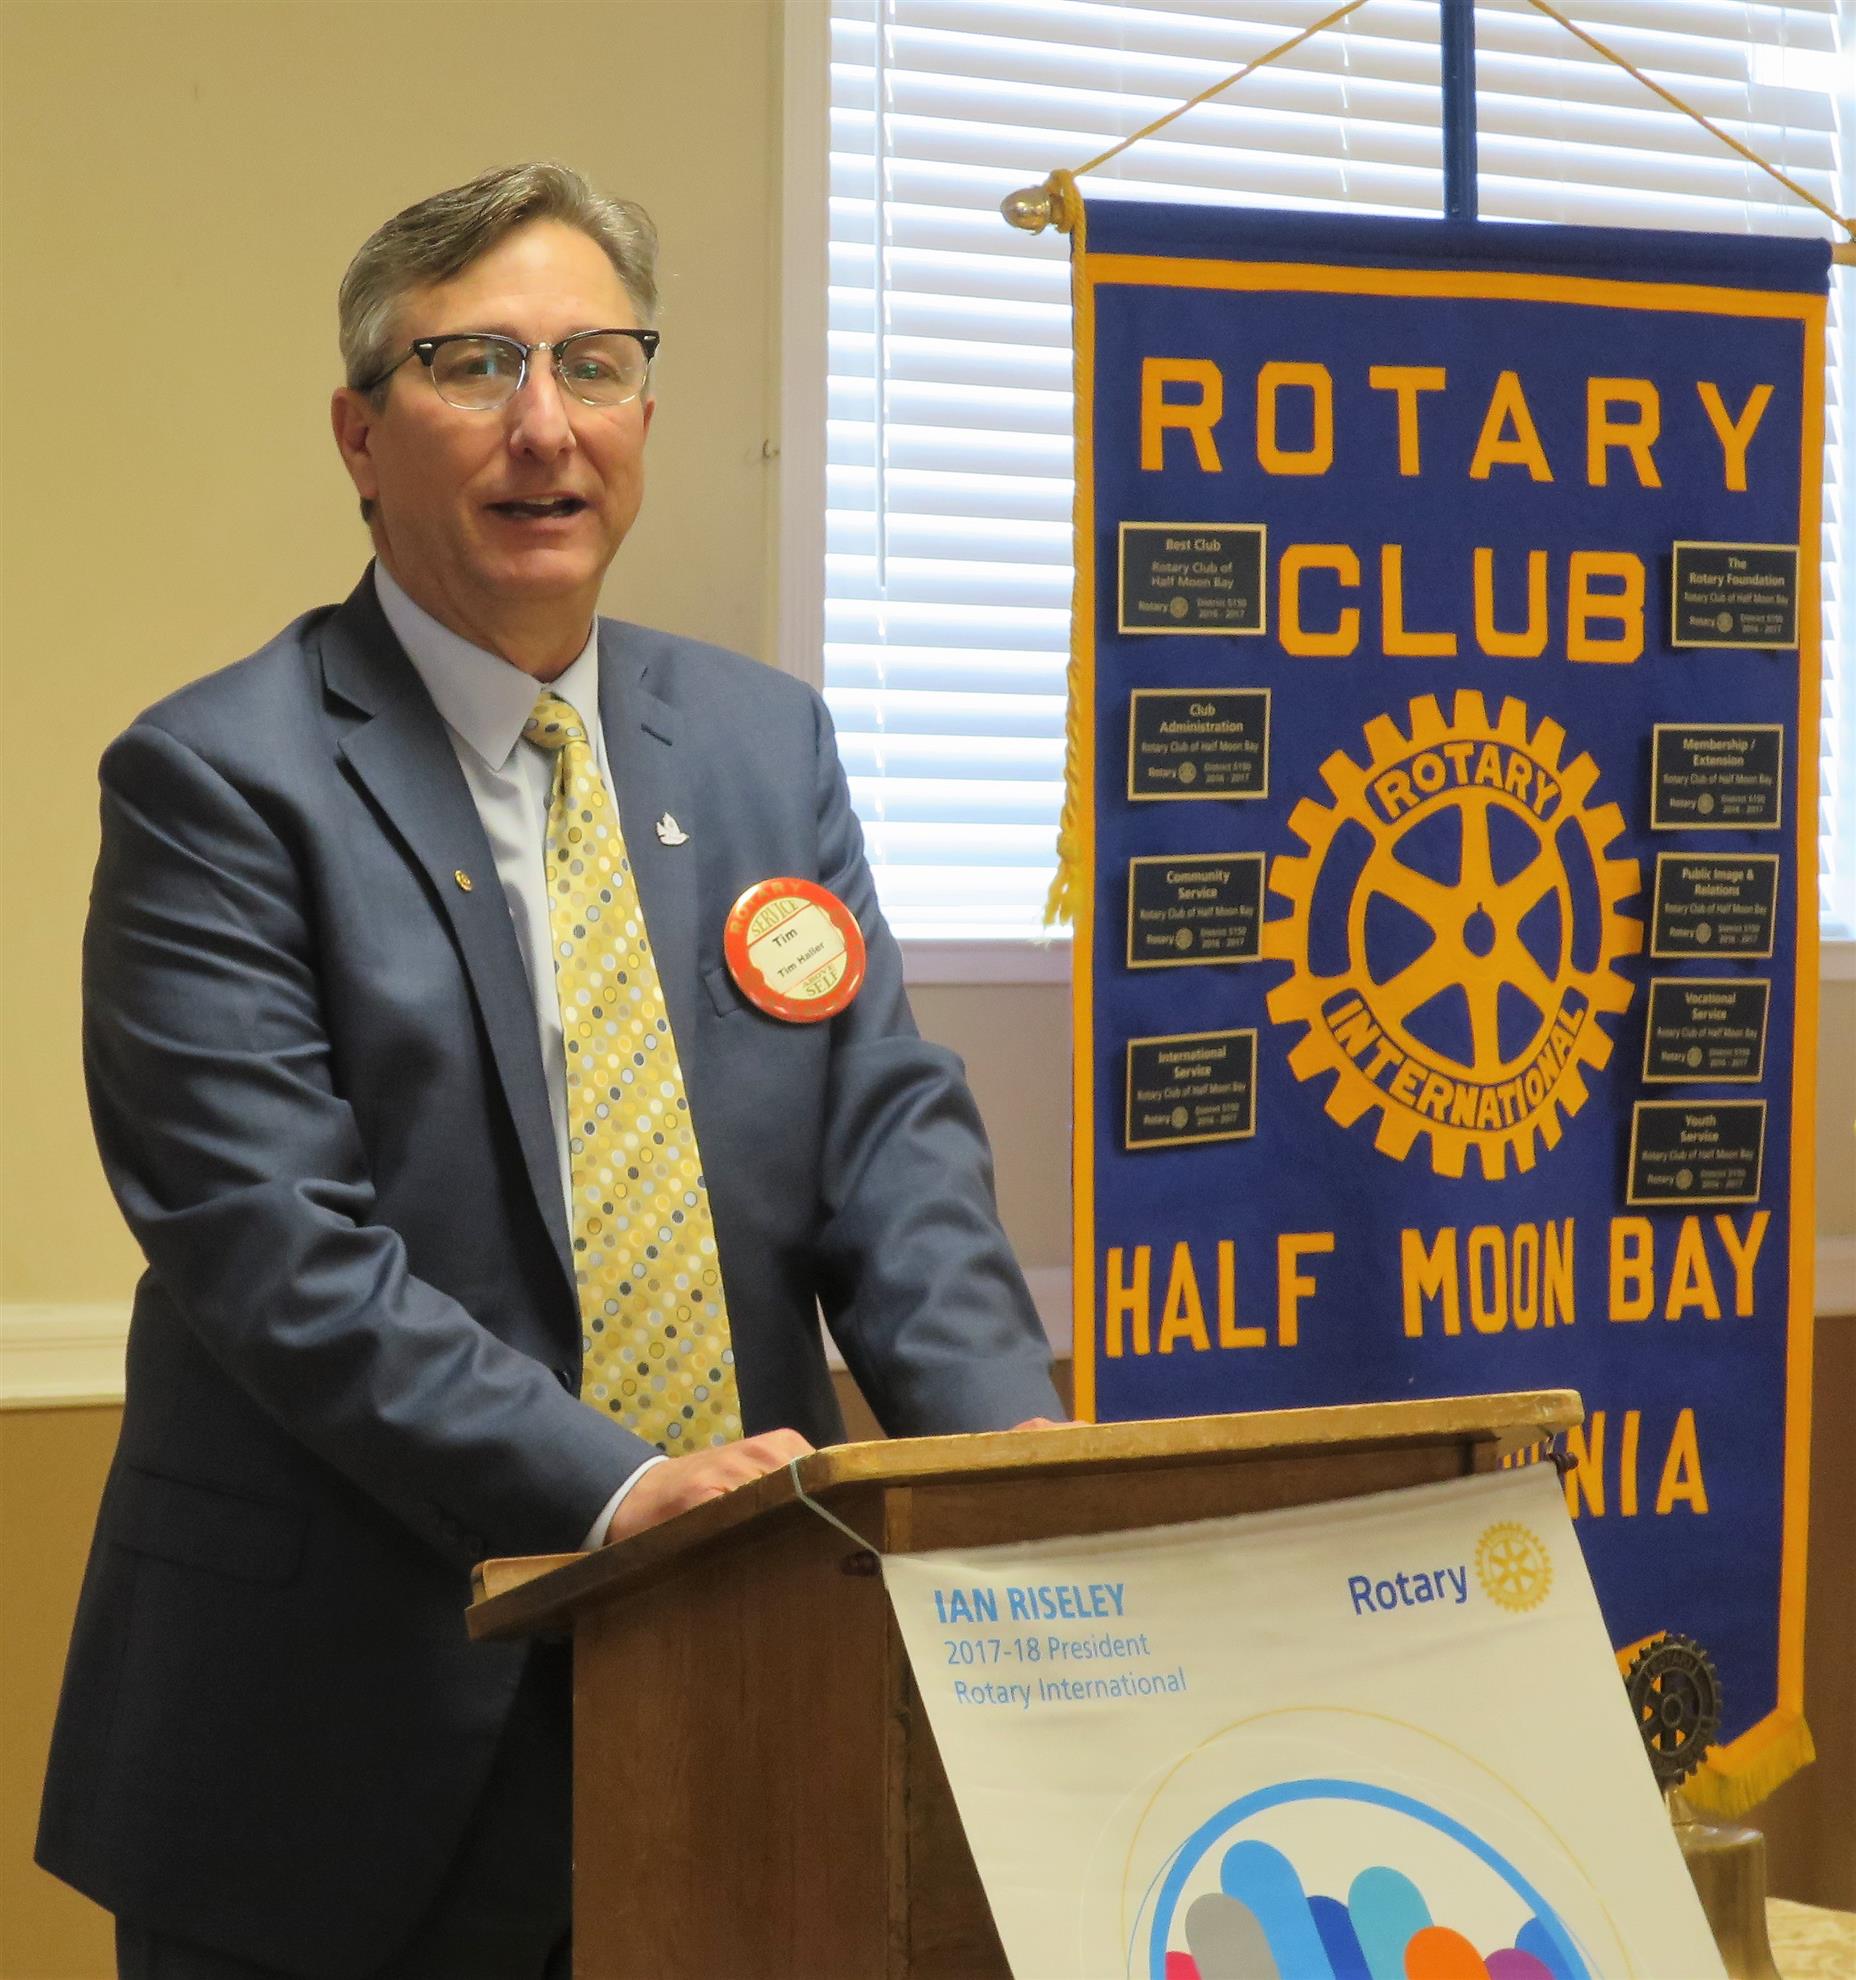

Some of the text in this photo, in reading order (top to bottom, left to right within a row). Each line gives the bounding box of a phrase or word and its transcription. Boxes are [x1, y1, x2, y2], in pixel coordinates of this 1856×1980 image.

[1140, 357, 1775, 492] ROTARY
[1166, 538, 1221, 552] Best Club
[1152, 561, 1233, 575] Rotary Club of
[1728, 557, 1747, 570] The
[1178, 576, 1211, 587] Moon
[1689, 572, 1785, 587] Rotary Foundation
[1278, 543, 1646, 664] CLUB
[1190, 703, 1216, 717] Club
[1160, 720, 1244, 733] Administration
[1683, 738, 1749, 753] Membership
[1693, 754, 1745, 767] Extension
[1373, 743, 1560, 819] ROTARY
[1166, 870, 1231, 884] Community
[1682, 866, 1712, 881] Public
[1713, 868, 1744, 884] Image
[1178, 887, 1218, 899] Service
[1694, 884, 1740, 897] Relations
[751, 899, 800, 937] SERVICE
[772, 927, 799, 948] Tim
[777, 942, 825, 979] Tim Haller
[806, 971, 840, 997] SELF
[1685, 992, 1737, 1005] Vocational
[1692, 1007, 1727, 1021] Service
[1158, 1045, 1227, 1063] International
[1327, 998, 1584, 1129] INTERNATIONAL
[1174, 1065, 1212, 1079] Service
[1685, 1114, 1717, 1128] Youth
[1680, 1129, 1720, 1143] Service
[1105, 1210, 1772, 1359] HALF MOON BAY
[1347, 1565, 1468, 1616] Rotary
[934, 1583, 1125, 1624] IAN RISELEY
[944, 1632, 1151, 1665] 2017-18 President
[954, 1666, 1188, 1710] Rotary International
